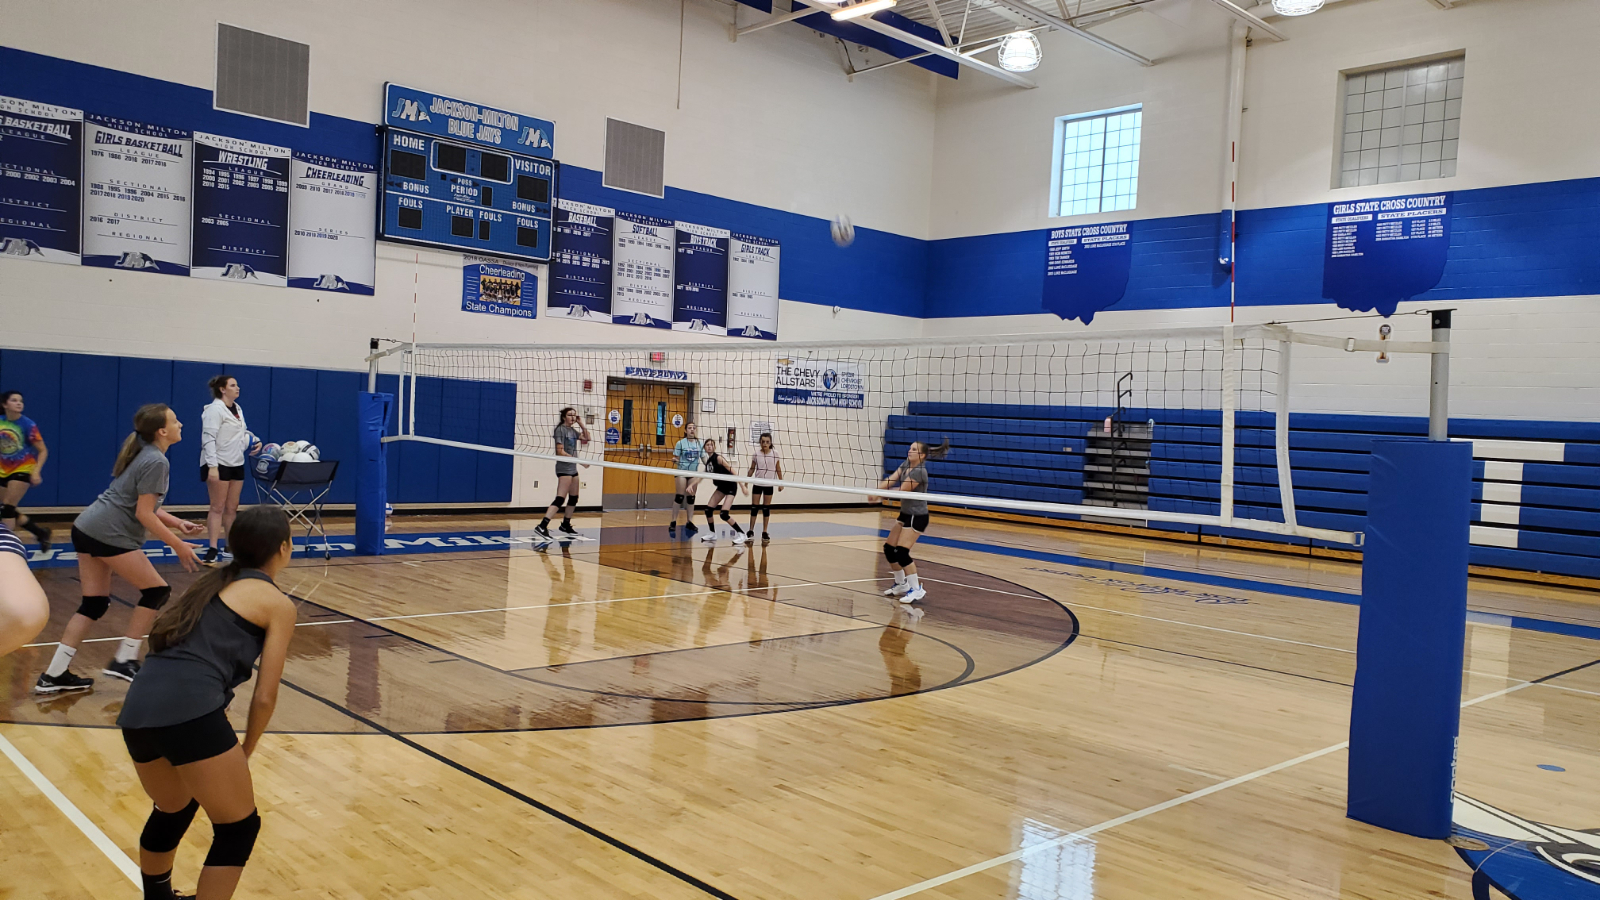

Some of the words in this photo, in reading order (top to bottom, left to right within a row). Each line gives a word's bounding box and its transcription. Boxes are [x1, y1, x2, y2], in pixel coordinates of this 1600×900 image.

[18, 108, 55, 118] SCHOOL
[32, 104, 76, 116] MILTON
[430, 97, 519, 132] JACKSON-MILTON
[4, 116, 72, 140] BASKETBALL
[90, 114, 140, 128] JACKSON
[147, 124, 188, 136] MILTON
[108, 123, 130, 132] HIGH
[134, 128, 168, 138] SCHOOL
[448, 118, 475, 140] BLUE
[476, 125, 502, 144] JAYS
[1, 128, 46, 140] LEAGUE
[95, 130, 124, 145] GIRLS
[125, 138, 184, 158] BASKETBALL
[199, 134, 244, 146] JACKSON
[250, 144, 286, 154] MILTON
[393, 134, 425, 150] HOME
[120, 148, 160, 158] LEAGUE
[240, 147, 268, 156] SCHOOL
[218, 150, 268, 170] WRESTLING
[296, 152, 337, 163] JACKSON
[342, 160, 374, 170] MILTON
[228, 166, 264, 176] LEAGUE
[514, 158, 552, 176] VISITOR
[306, 166, 364, 186] CHEERLEADING
[457, 178, 473, 187] POSS
[110, 178, 168, 192] SECTIONAL
[402, 181, 430, 194] BONUS
[450, 184, 478, 197] PERIOD
[398, 196, 423, 209] FOULS
[512, 201, 536, 214] BONUS
[1334, 203, 1356, 214] GIRLS
[1356, 201, 1380, 213] STATE
[1380, 198, 1406, 210] CROSS
[1406, 195, 1446, 208] COUNTRY
[114, 212, 162, 222] DISTRICT
[218, 214, 270, 224] SECTIONAL
[446, 204, 474, 218] PLAYER
[479, 210, 502, 222] FOULS
[568, 212, 597, 227] BASEBALL
[618, 212, 646, 220] JACKSON
[649, 216, 672, 225] MILTON
[516, 217, 539, 228] FOULS
[112, 232, 164, 242] REGIONAL
[632, 224, 658, 237] SOFTBALL
[1051, 230, 1064, 239] BOYS
[1064, 228, 1082, 238] STATE
[1082, 226, 1100, 236] CROSS
[1100, 224, 1128, 234] COUNTRY
[222, 245, 266, 254] DISTRICT
[740, 244, 754, 253] GIRLS
[754, 246, 770, 256] TRACK
[479, 264, 526, 282] Cheerleading
[466, 301, 487, 312] State
[488, 304, 532, 317] Champions
[776, 366, 792, 376] THE
[794, 367, 820, 378] CHEVY
[776, 376, 816, 388] ALLSTARS
